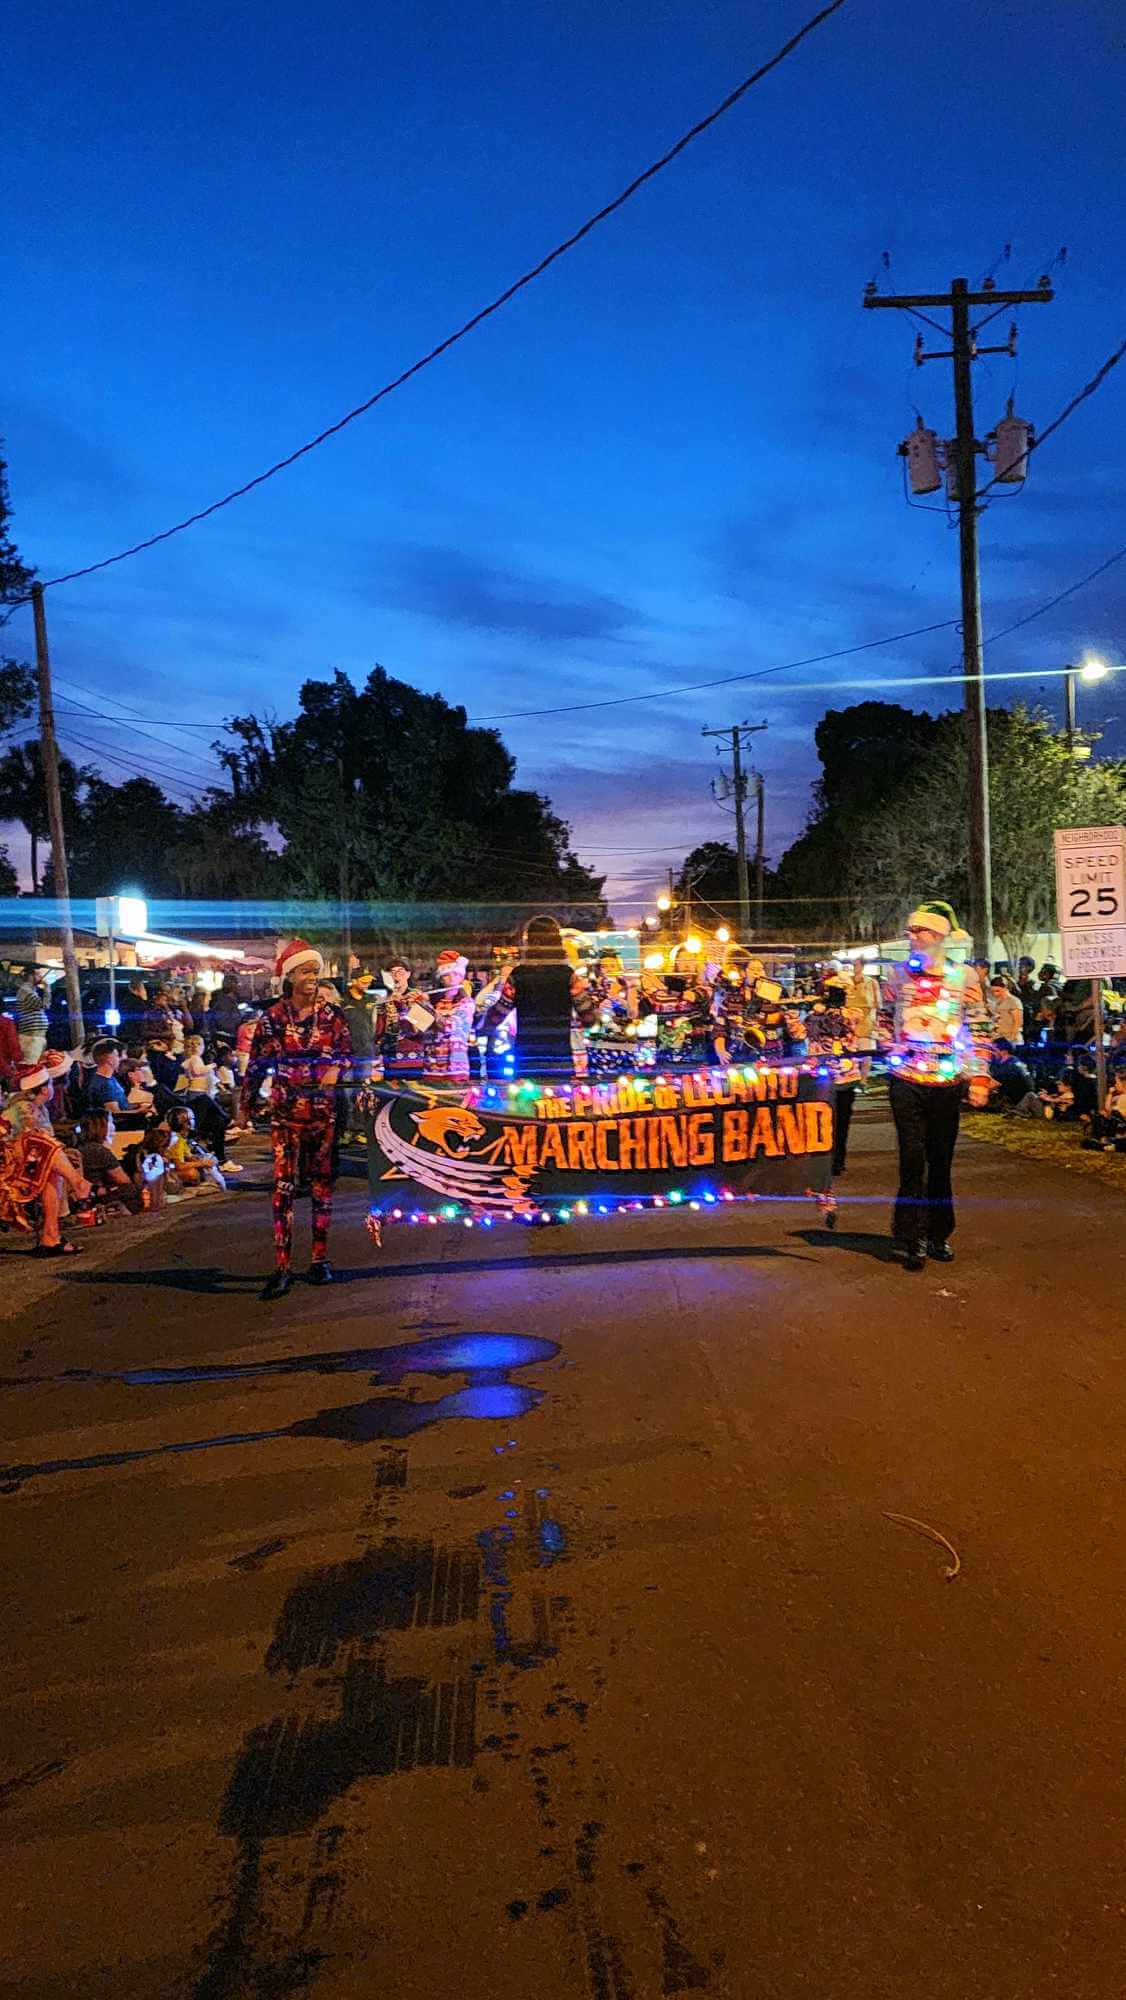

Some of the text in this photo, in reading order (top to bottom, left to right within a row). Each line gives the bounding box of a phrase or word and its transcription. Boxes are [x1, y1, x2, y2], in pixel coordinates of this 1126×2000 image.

[1064, 855, 1119, 869] SPEED
[1070, 871, 1113, 885] LIMIT
[1069, 888, 1119, 918] 25
[534, 1098, 571, 1119] THE
[574, 1080, 652, 1116] PRIDE
[654, 1079, 682, 1109] OF
[501, 1102, 834, 1170] MARCHING BAND
